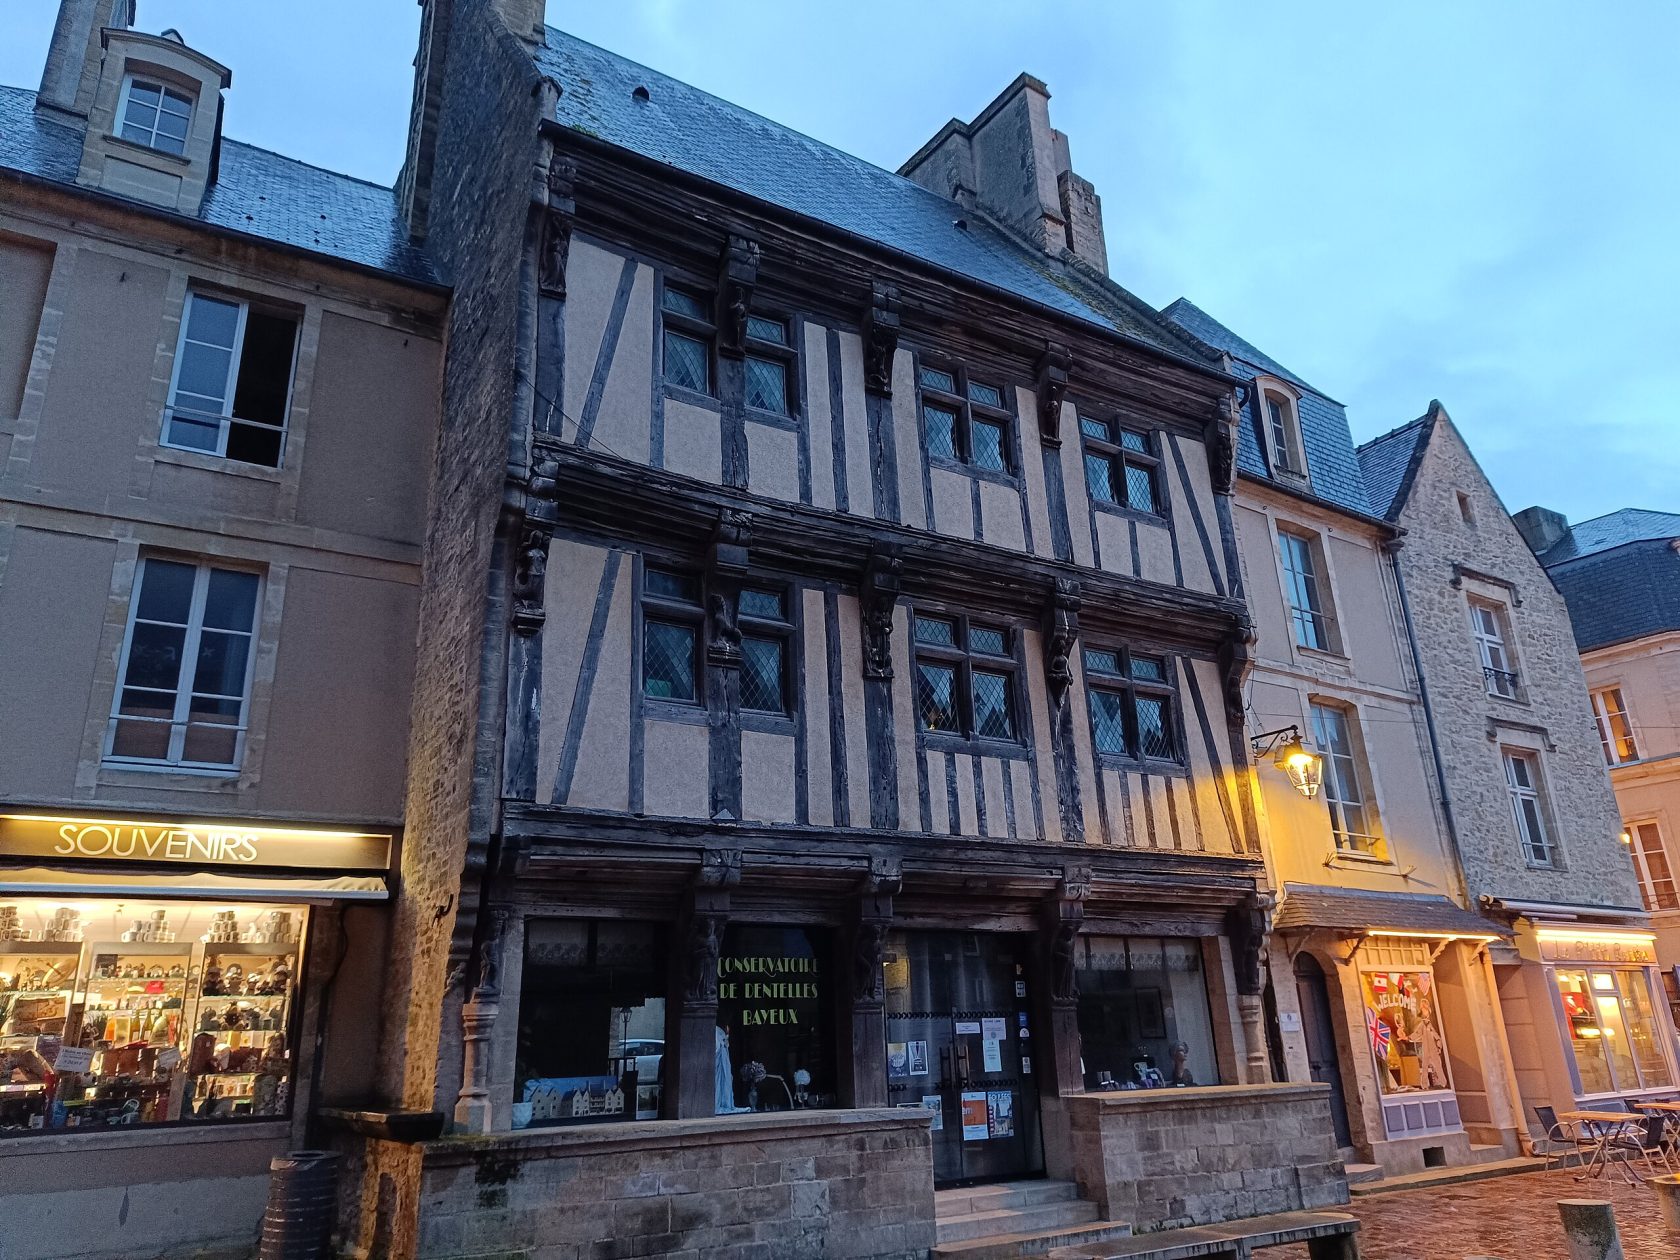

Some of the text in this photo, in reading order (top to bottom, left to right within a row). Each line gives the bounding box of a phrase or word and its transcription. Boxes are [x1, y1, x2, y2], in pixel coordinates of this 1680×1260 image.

[54, 825, 259, 862] SOUVENIRS
[717, 957, 820, 978] CONSERVATOIRE
[720, 982, 818, 999] DE DENTELLES
[742, 1008, 799, 1026] BAYEUX
